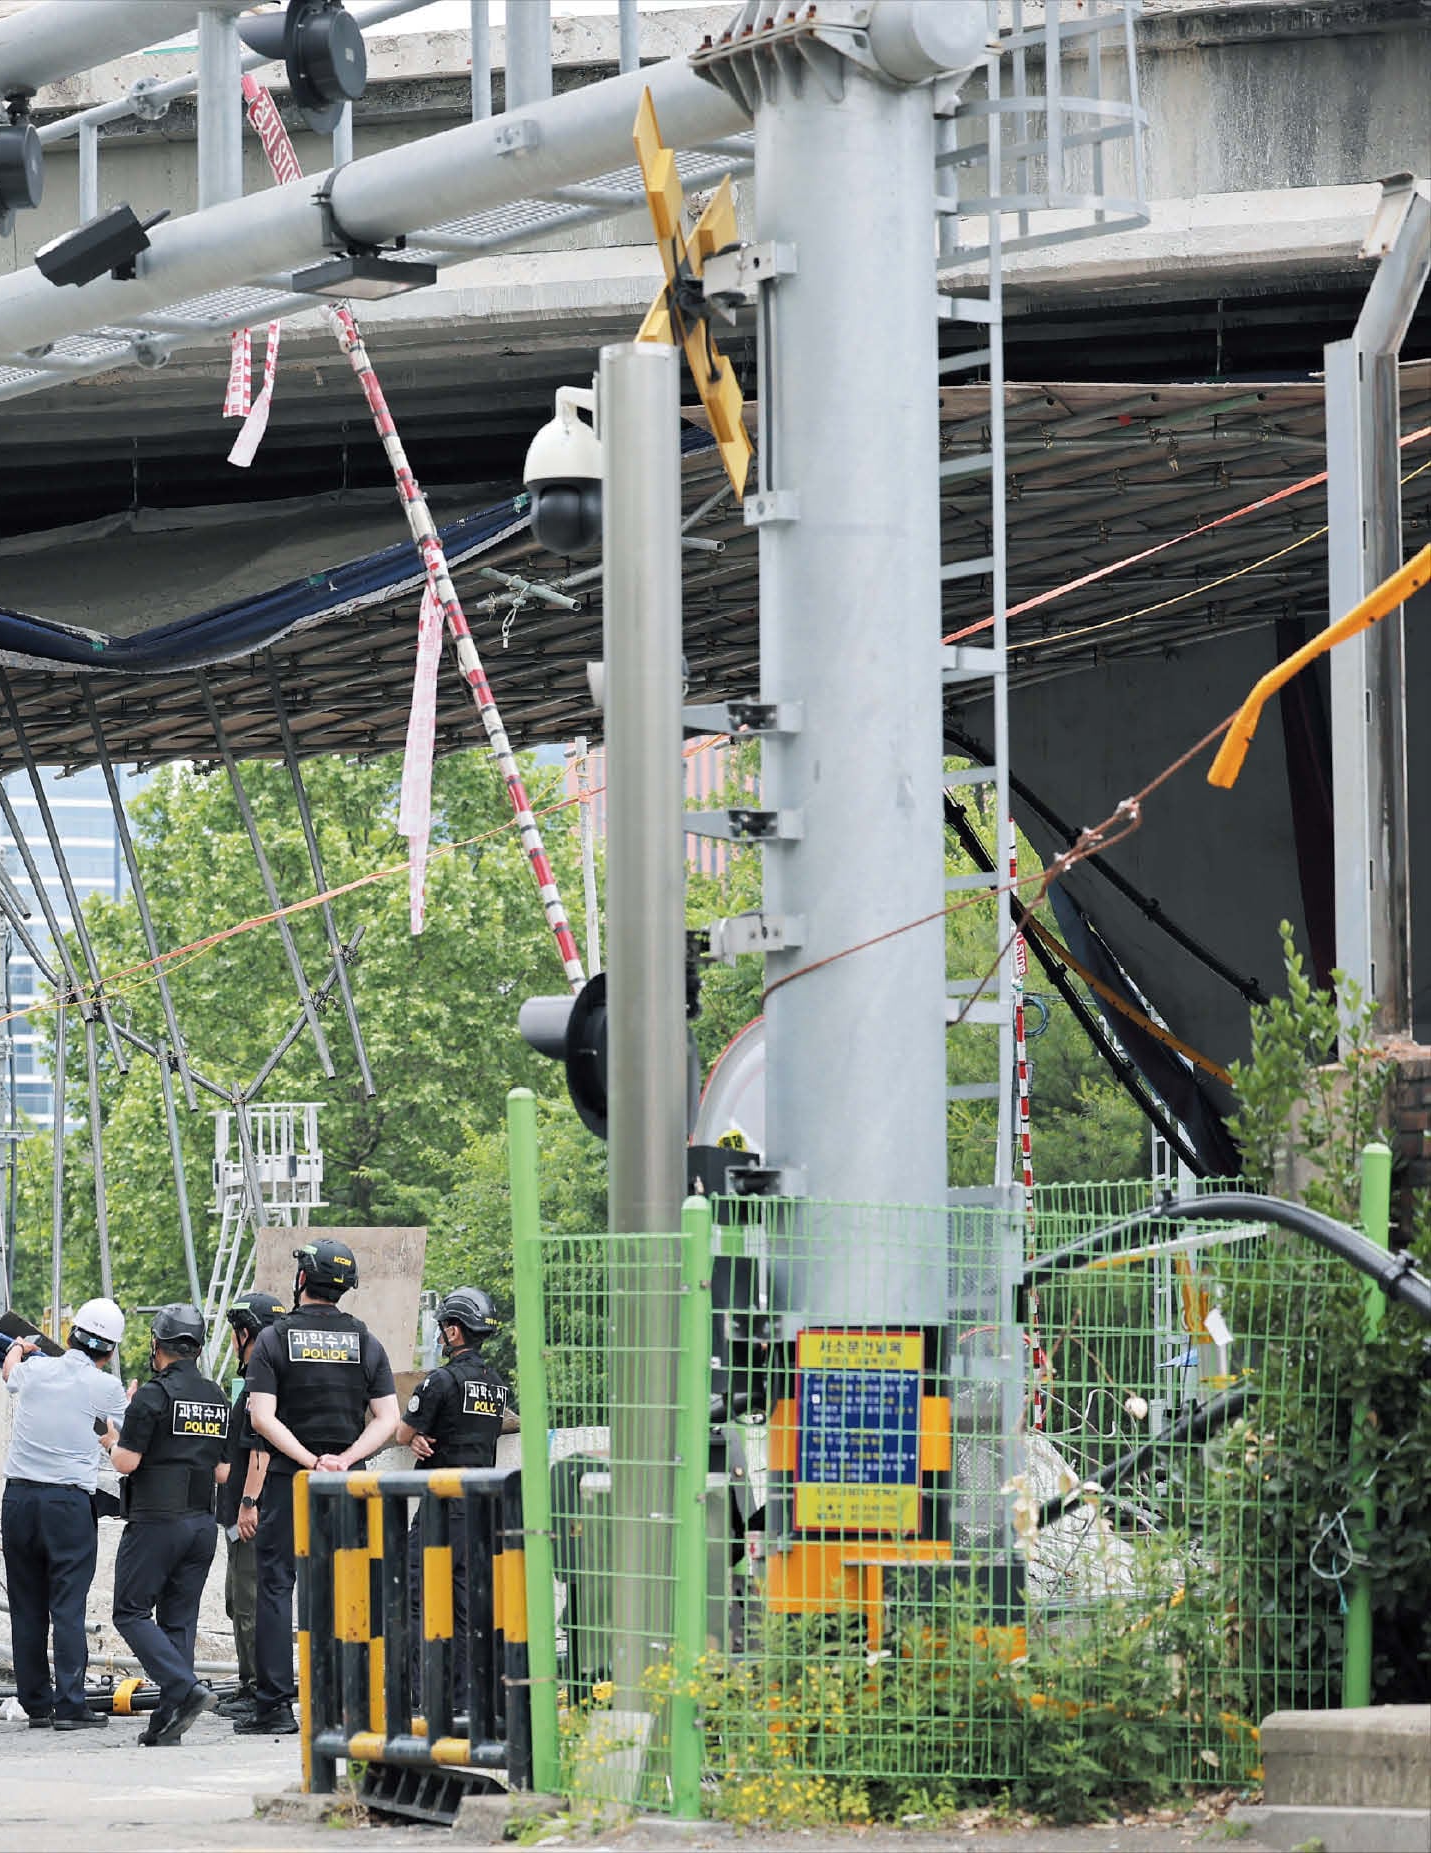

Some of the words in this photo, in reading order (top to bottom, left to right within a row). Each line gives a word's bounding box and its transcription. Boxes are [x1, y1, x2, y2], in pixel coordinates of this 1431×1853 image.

[293, 1332, 354, 1349] 과학수사
[302, 1348, 348, 1361] POLICE
[178, 1404, 227, 1423] 과학수사
[184, 1421, 221, 1435] POLICE
